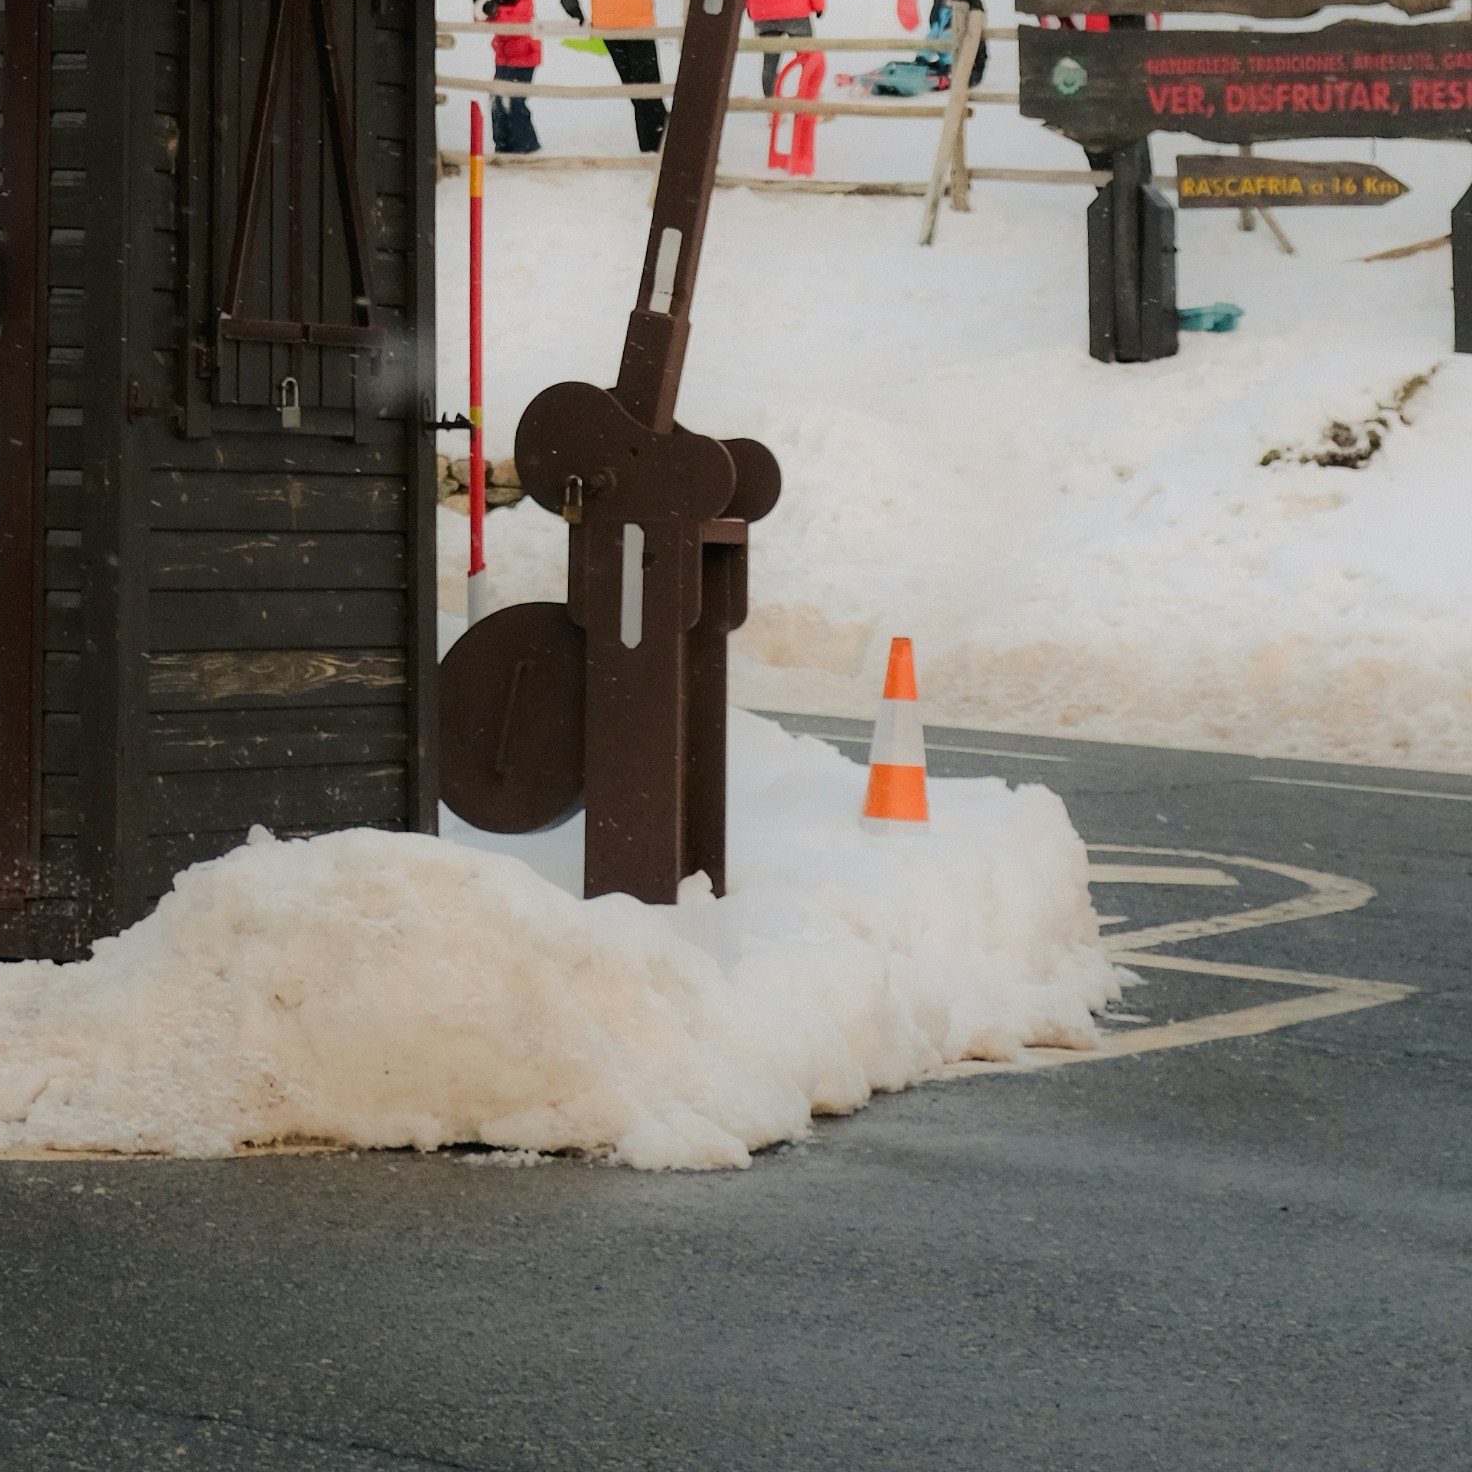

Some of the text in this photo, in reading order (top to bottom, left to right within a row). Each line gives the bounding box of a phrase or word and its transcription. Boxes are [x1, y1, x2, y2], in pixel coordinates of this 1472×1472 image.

[1146, 82, 1215, 118] VER,
[1223, 79, 1400, 116] DISFRUTAR,
[1180, 175, 1304, 197] RASCAFRIA
[1332, 175, 1358, 196] 16
